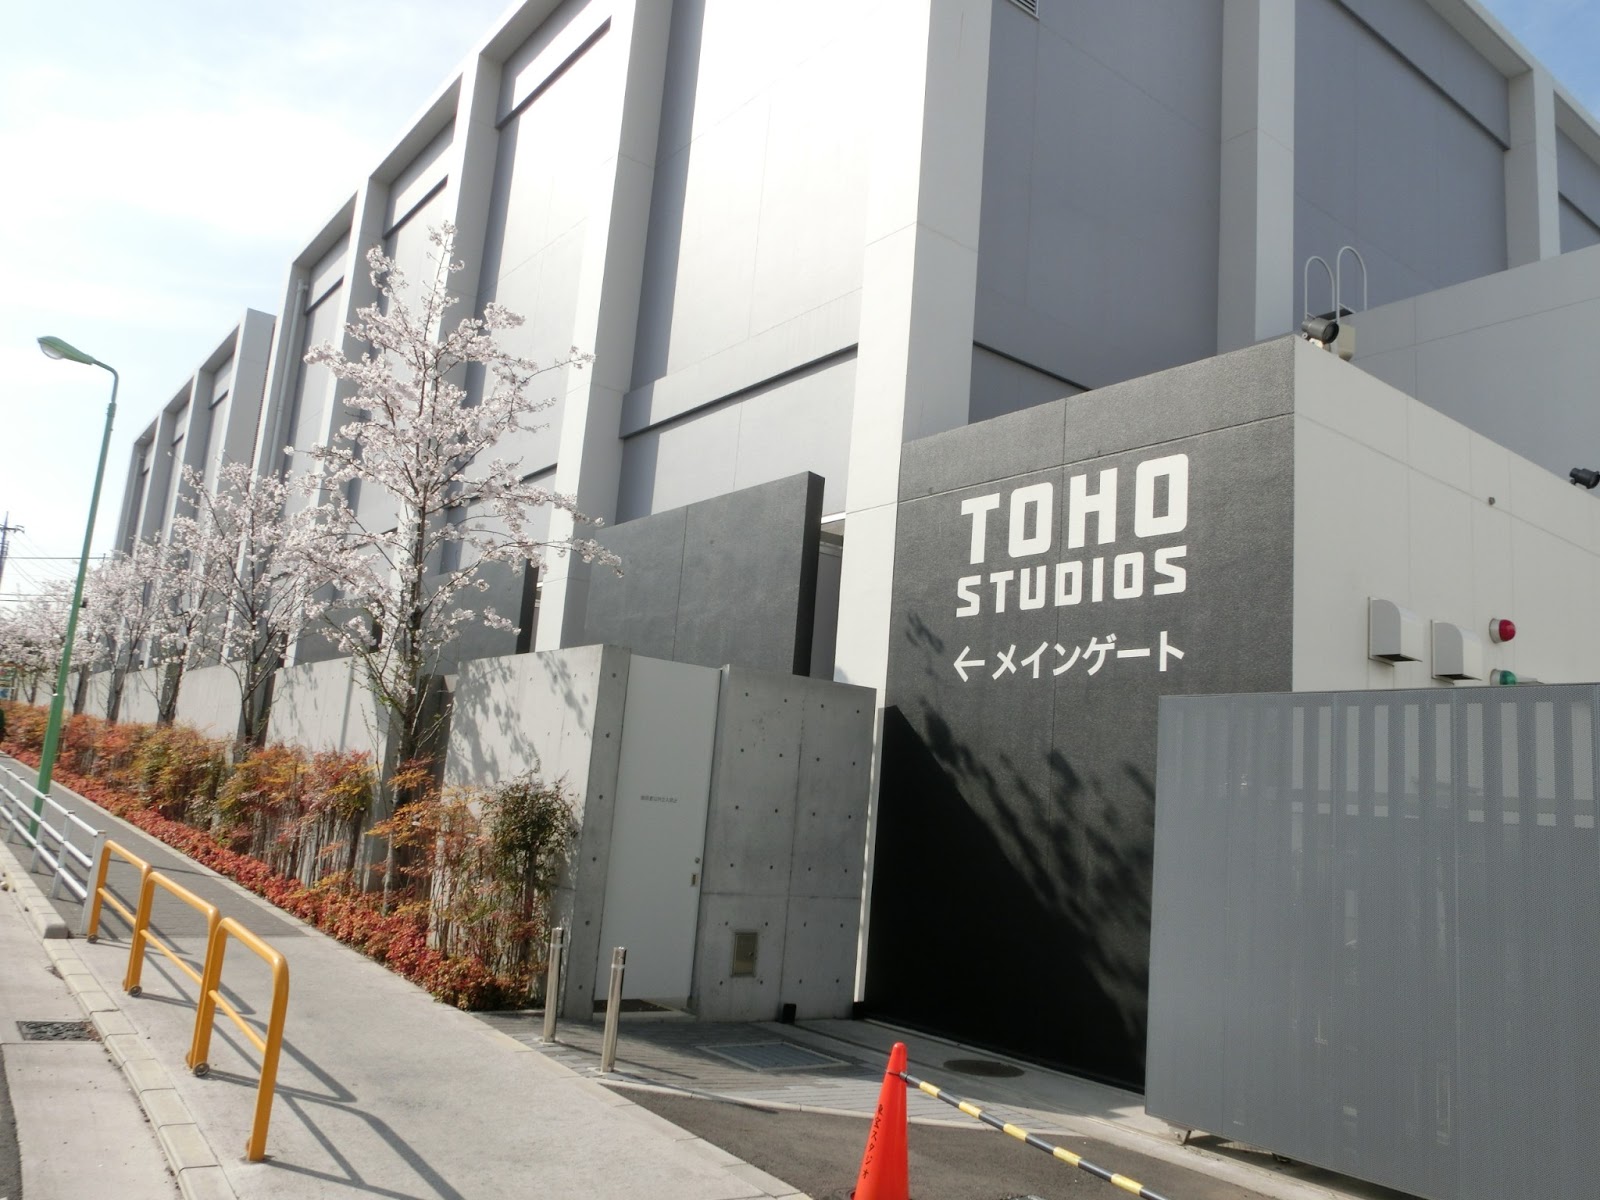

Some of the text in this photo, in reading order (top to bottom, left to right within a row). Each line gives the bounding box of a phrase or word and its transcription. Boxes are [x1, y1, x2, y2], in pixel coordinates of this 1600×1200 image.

[960, 453, 1189, 565] TOHO
[955, 545, 1187, 618] STUDIOS
[991, 630, 1185, 680] メインゲート
